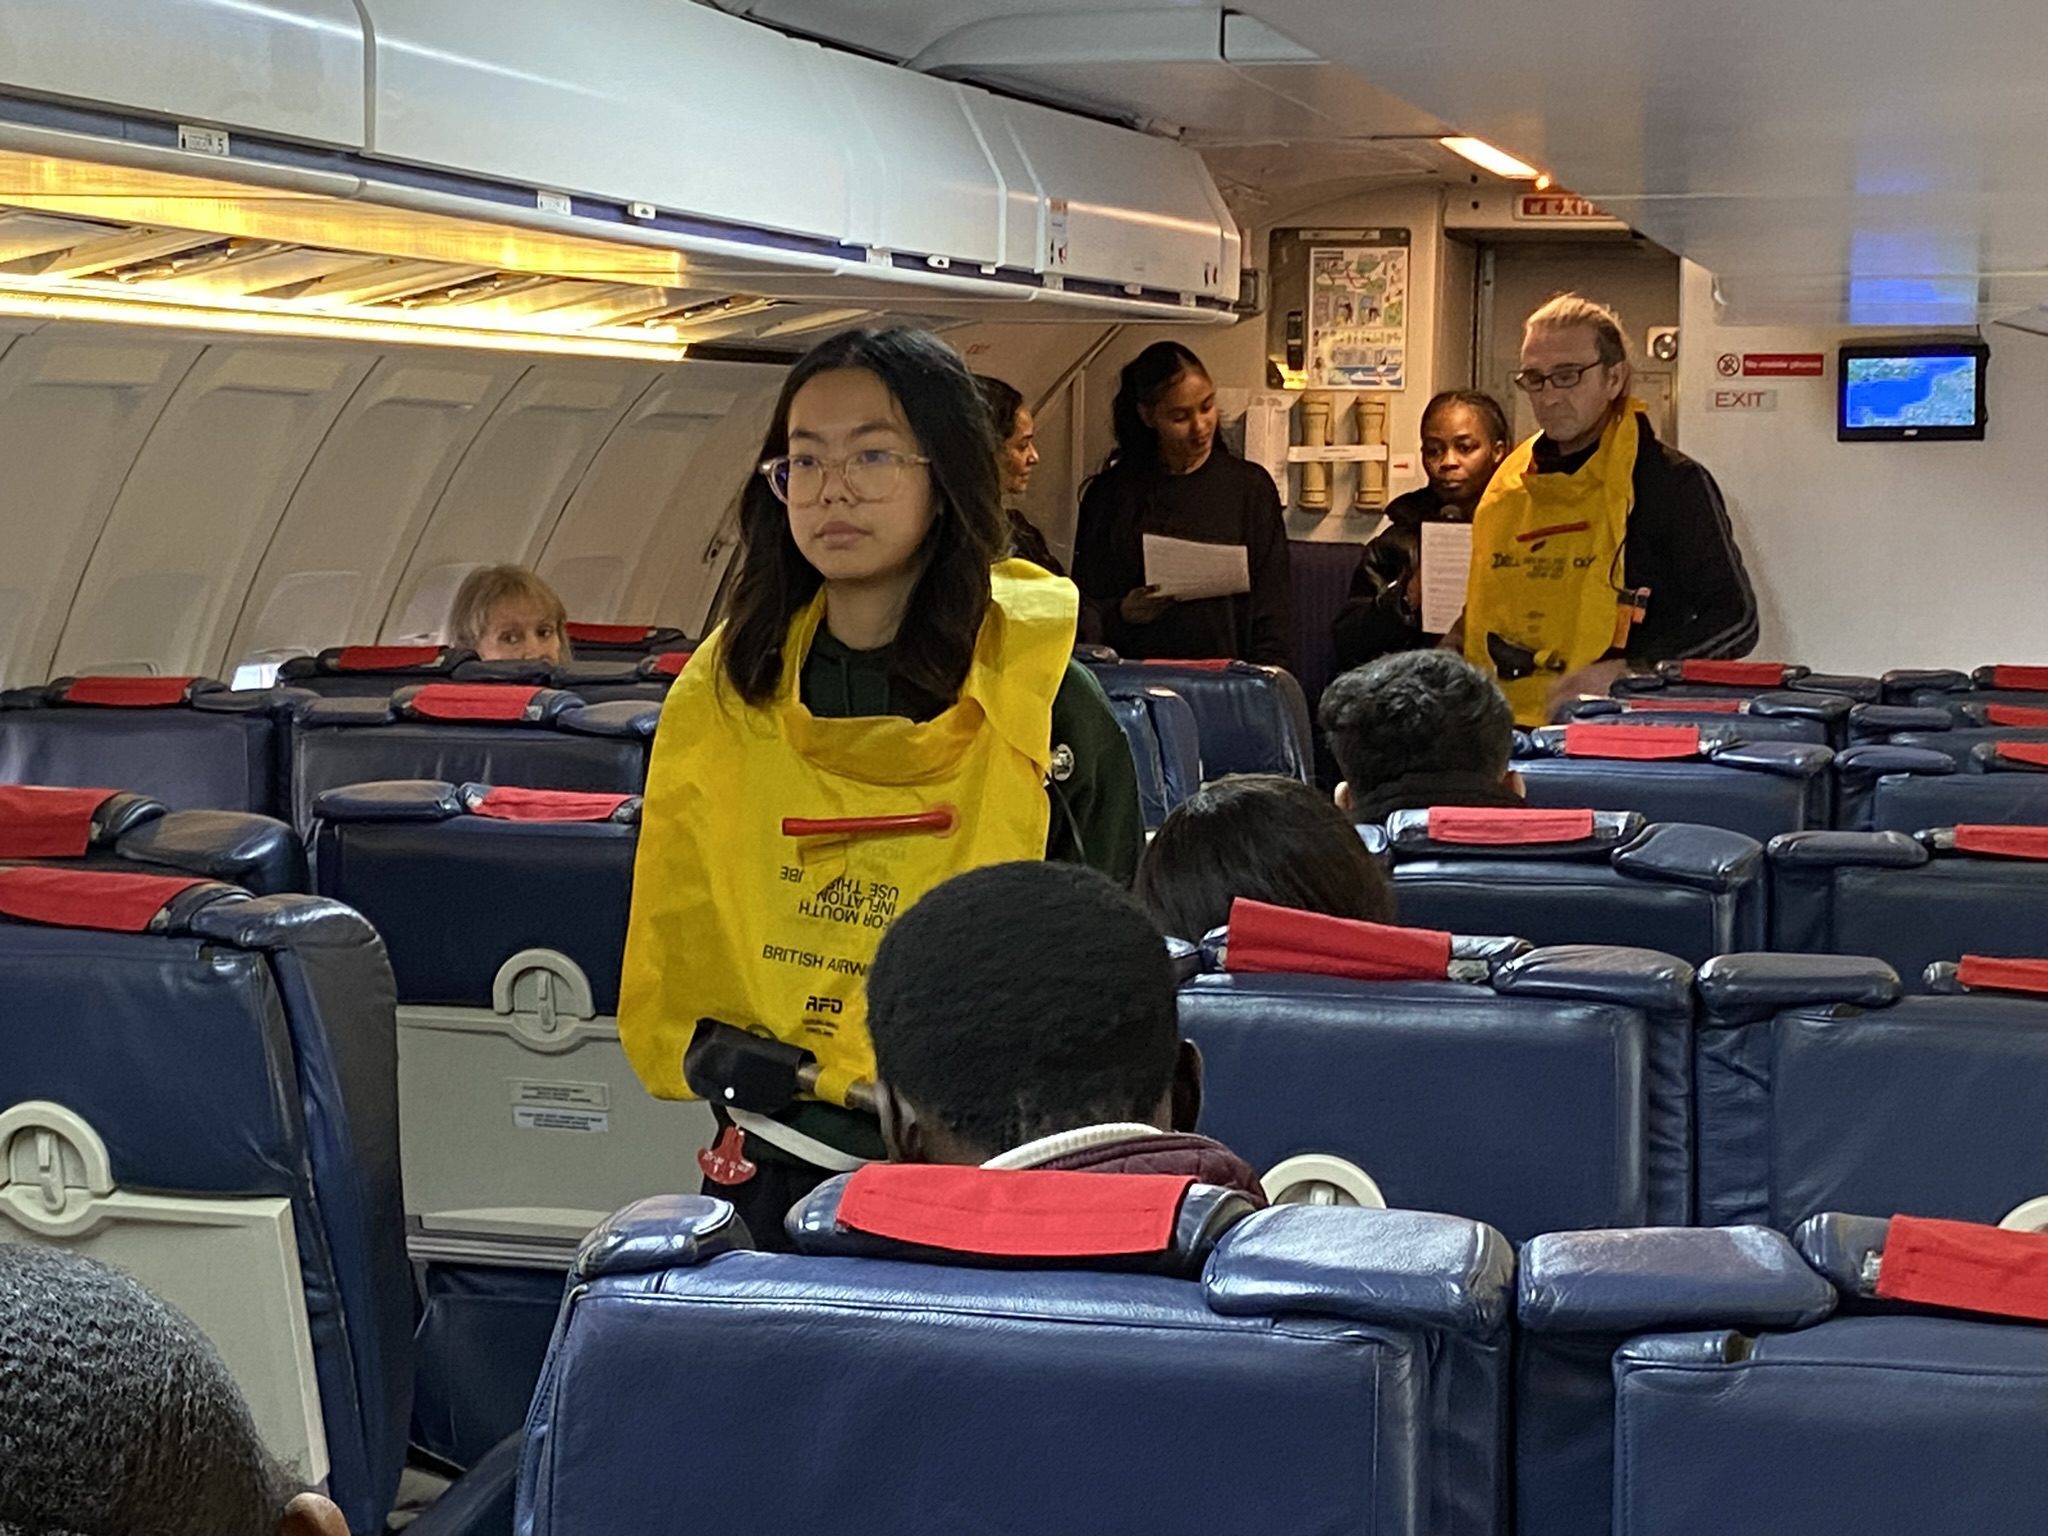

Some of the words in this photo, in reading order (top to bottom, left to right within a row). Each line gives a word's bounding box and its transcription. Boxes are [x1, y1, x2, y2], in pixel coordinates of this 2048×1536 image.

[1715, 391, 1766, 408] EXIT
[816, 890, 896, 916] INFLATION
[870, 882, 899, 901] USE
[798, 901, 860, 925] MOUTH
[762, 944, 824, 969] BRITISH
